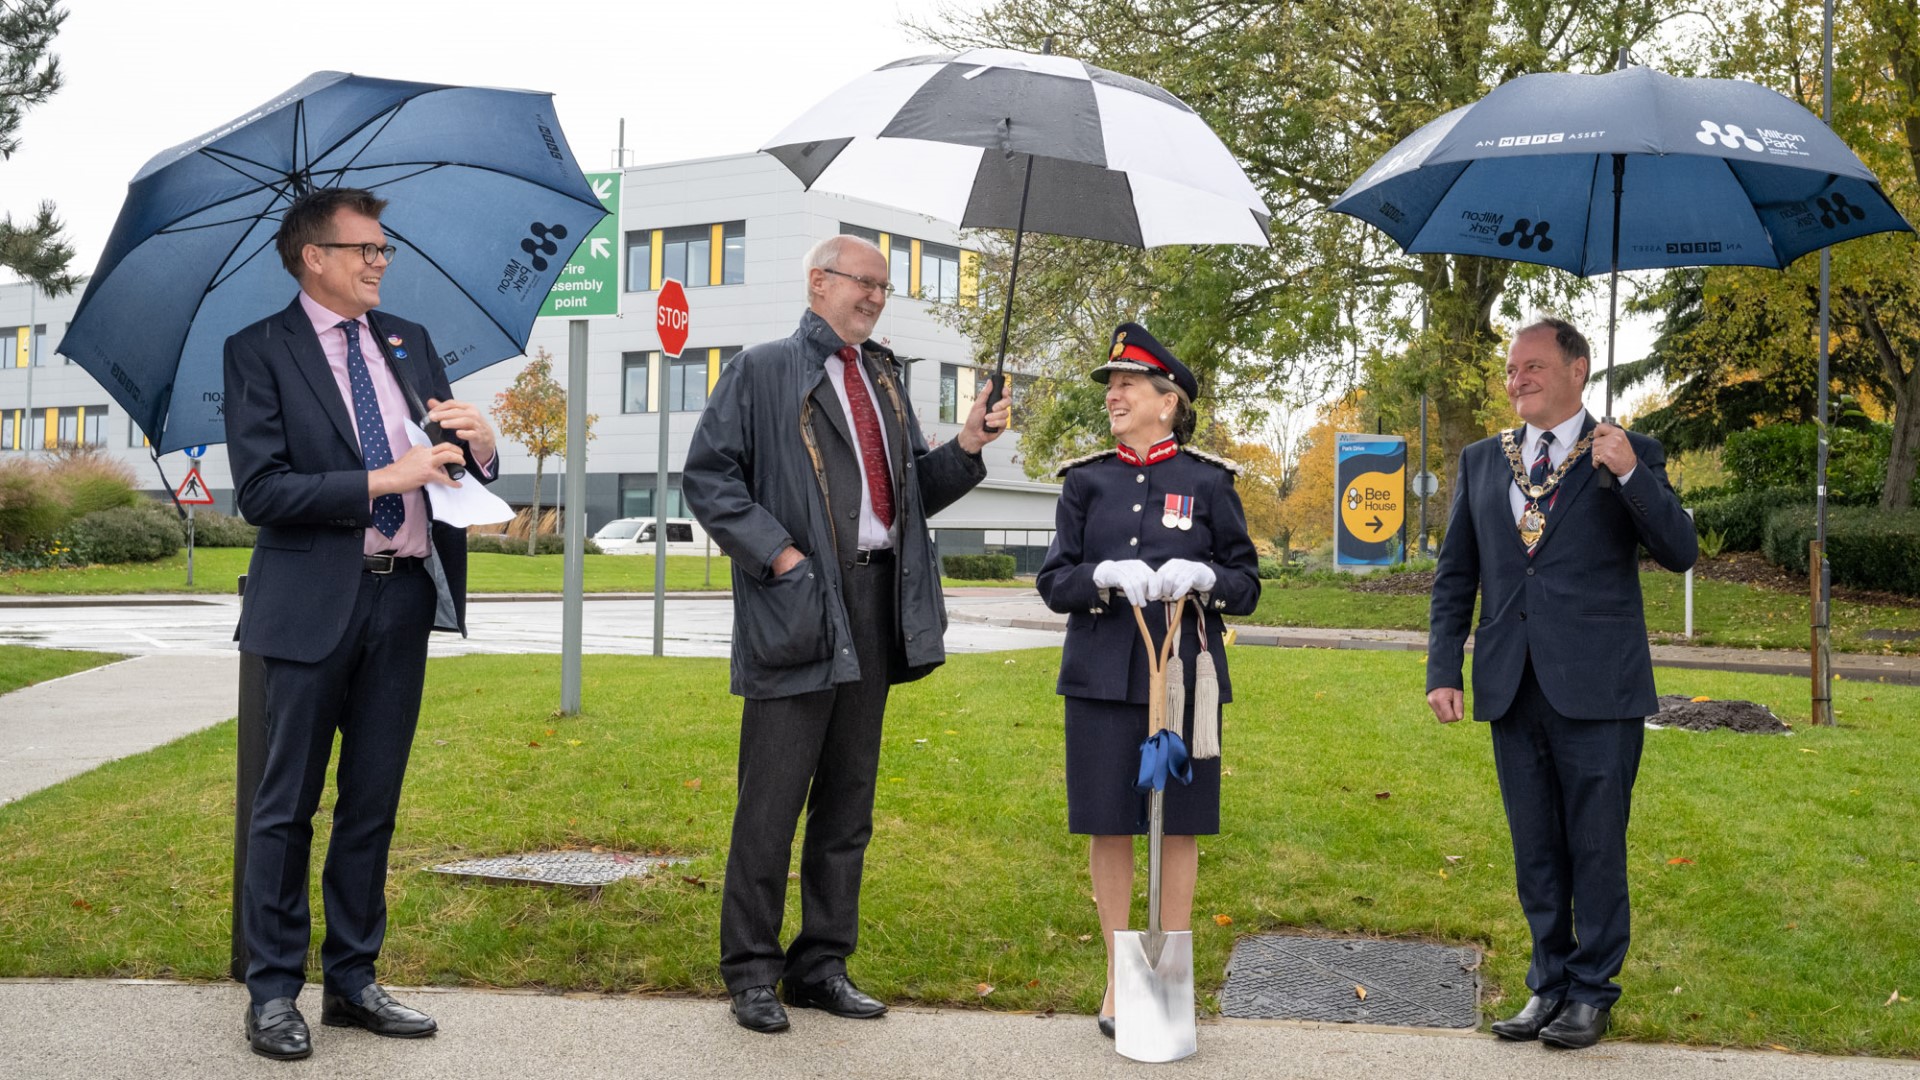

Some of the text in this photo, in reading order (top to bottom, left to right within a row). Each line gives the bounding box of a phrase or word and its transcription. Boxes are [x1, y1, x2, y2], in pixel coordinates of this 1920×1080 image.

[1498, 132, 1565, 148] MEPC
[1568, 131, 1606, 140] ASSET
[1756, 128, 1806, 143] Milton
[1762, 136, 1799, 150] Park
[551, 279, 603, 294] ssembly
[555, 296, 587, 310] point
[658, 305, 688, 330] STOP
[1365, 487, 1391, 500] Bee
[1365, 501, 1397, 511] House
